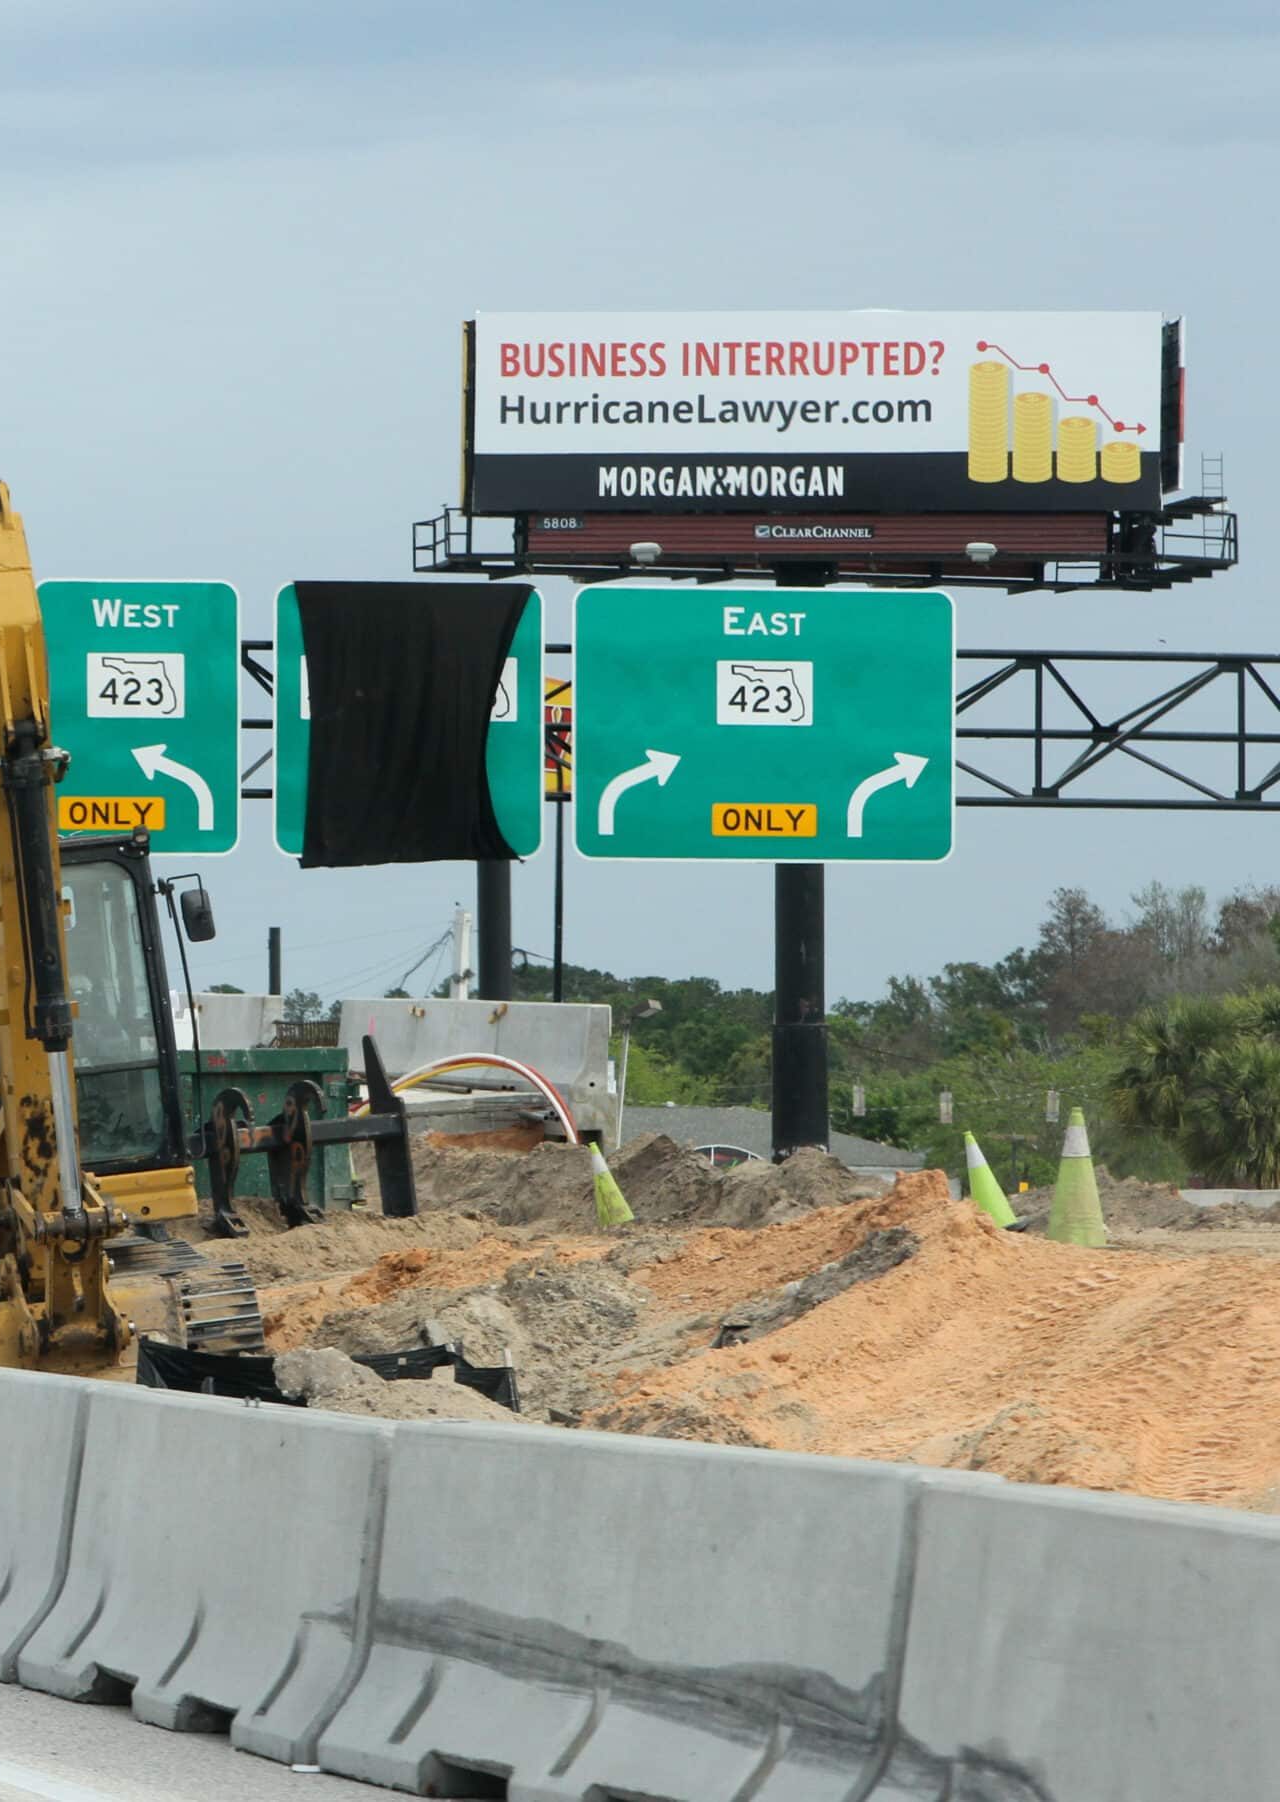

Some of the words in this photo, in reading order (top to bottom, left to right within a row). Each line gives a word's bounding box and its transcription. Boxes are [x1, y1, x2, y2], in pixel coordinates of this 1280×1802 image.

[500, 341, 667, 377] BUSINESS
[682, 340, 946, 377] INTERRUPTED?
[500, 393, 932, 433] HurricaneLawyer.com
[543, 518, 577, 529] 5808
[92, 599, 180, 628] WEST
[723, 606, 806, 636] EAST
[99, 677, 164, 706] 423
[728, 685, 793, 713] 423
[69, 801, 154, 826] ONLY
[722, 808, 806, 832] ONLY
